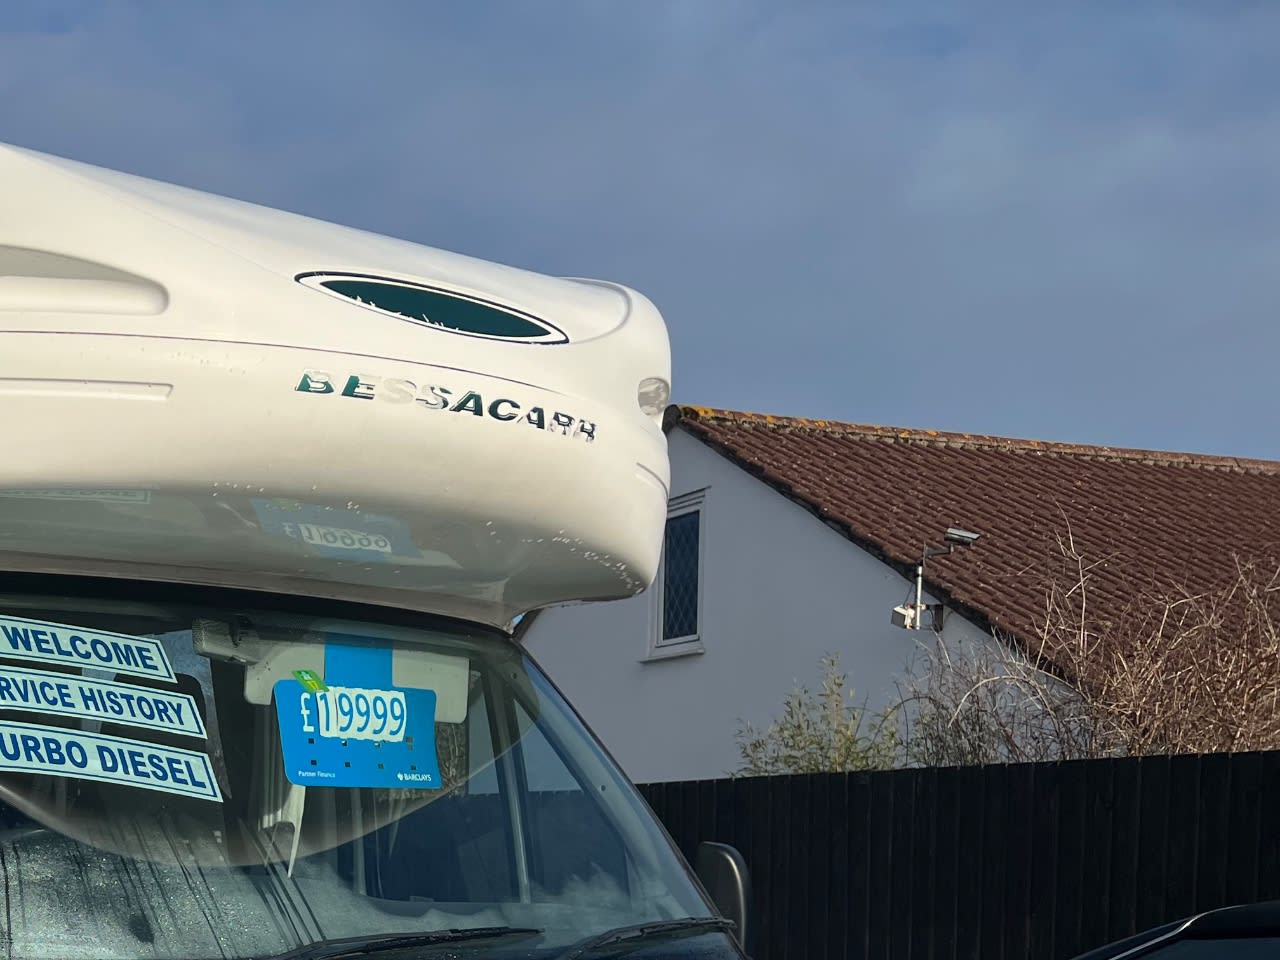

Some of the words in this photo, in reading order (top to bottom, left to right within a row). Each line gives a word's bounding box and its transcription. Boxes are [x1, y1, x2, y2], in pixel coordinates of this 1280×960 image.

[0, 624, 159, 671] WELCOME
[79, 687, 186, 726] HISTORY
[300, 692, 405, 736] £19999
[97, 745, 207, 788] DIESEL
